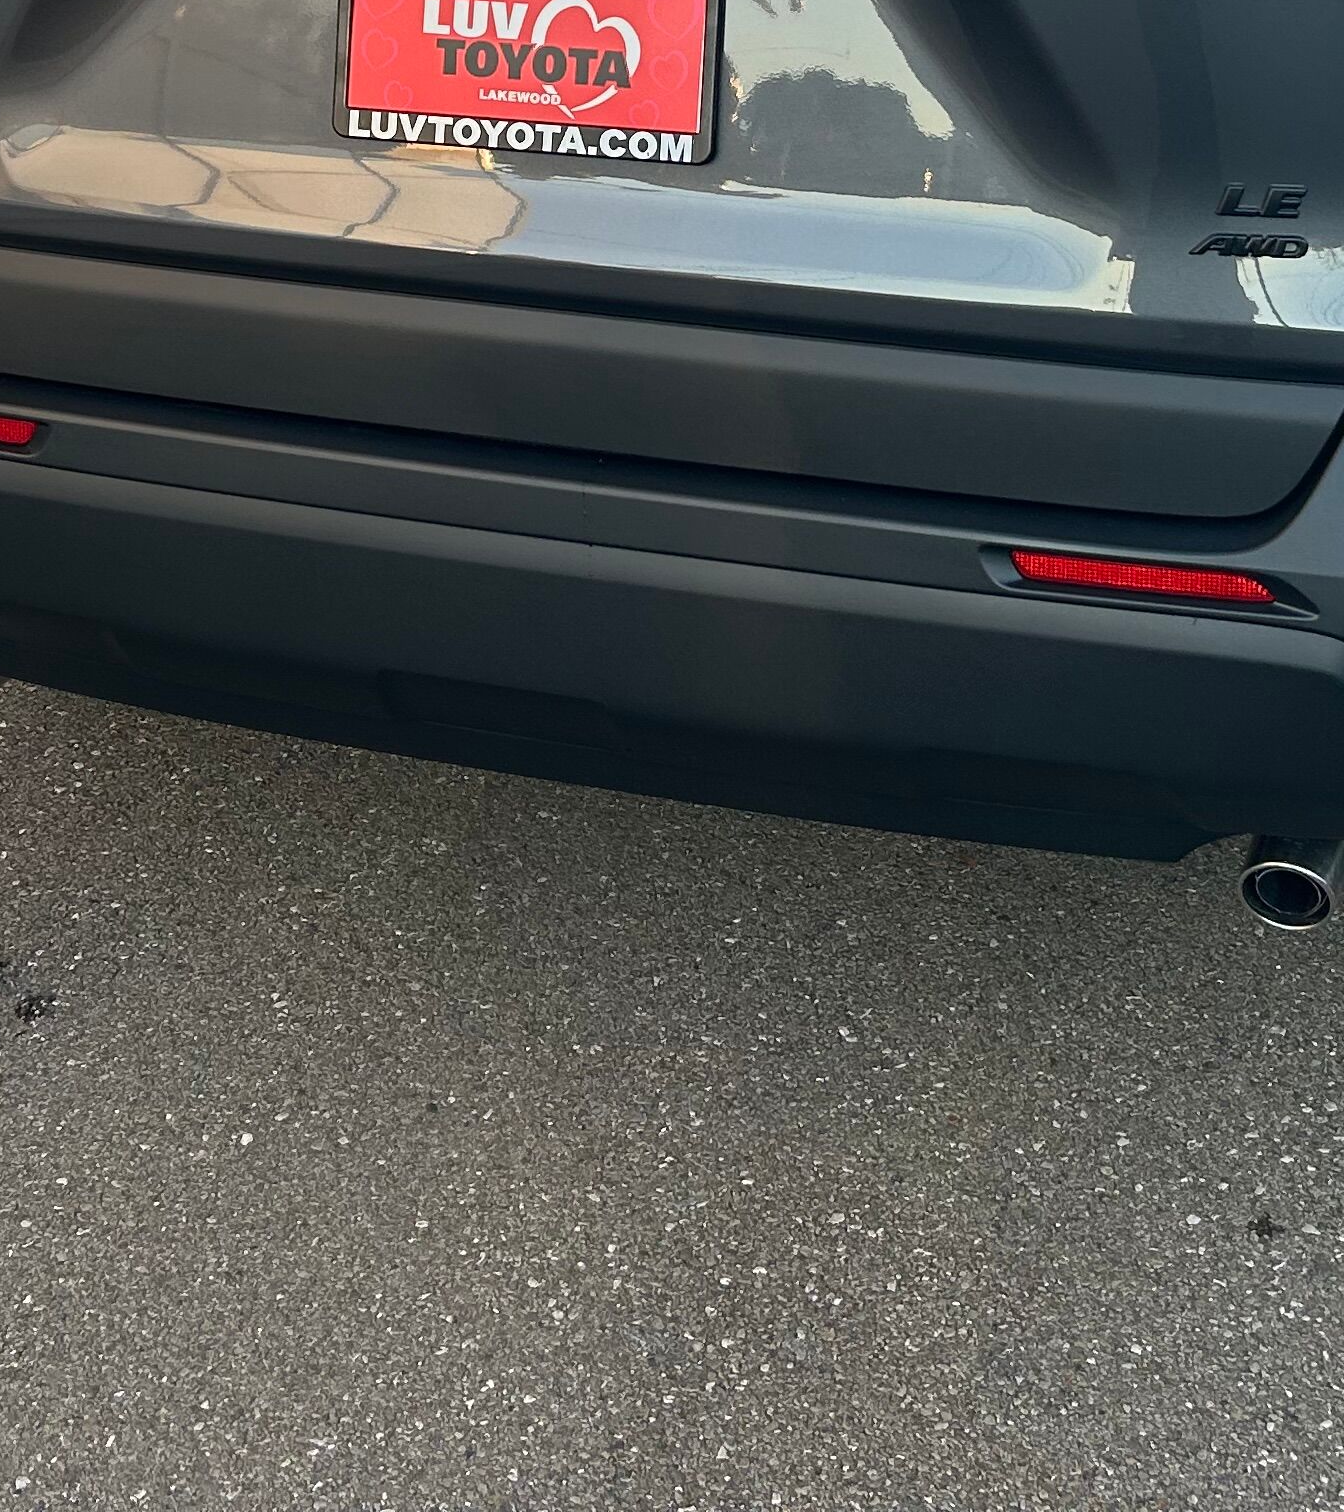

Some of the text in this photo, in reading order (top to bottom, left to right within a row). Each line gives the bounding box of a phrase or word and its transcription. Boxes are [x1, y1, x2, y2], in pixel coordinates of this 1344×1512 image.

[436, 38, 632, 88] TOYOTA
[479, 88, 562, 106] LAKEWOOD
[348, 109, 695, 164] LUVTOYOTA.COM
[1215, 182, 1309, 219] LE
[1188, 232, 1309, 259] AWD
